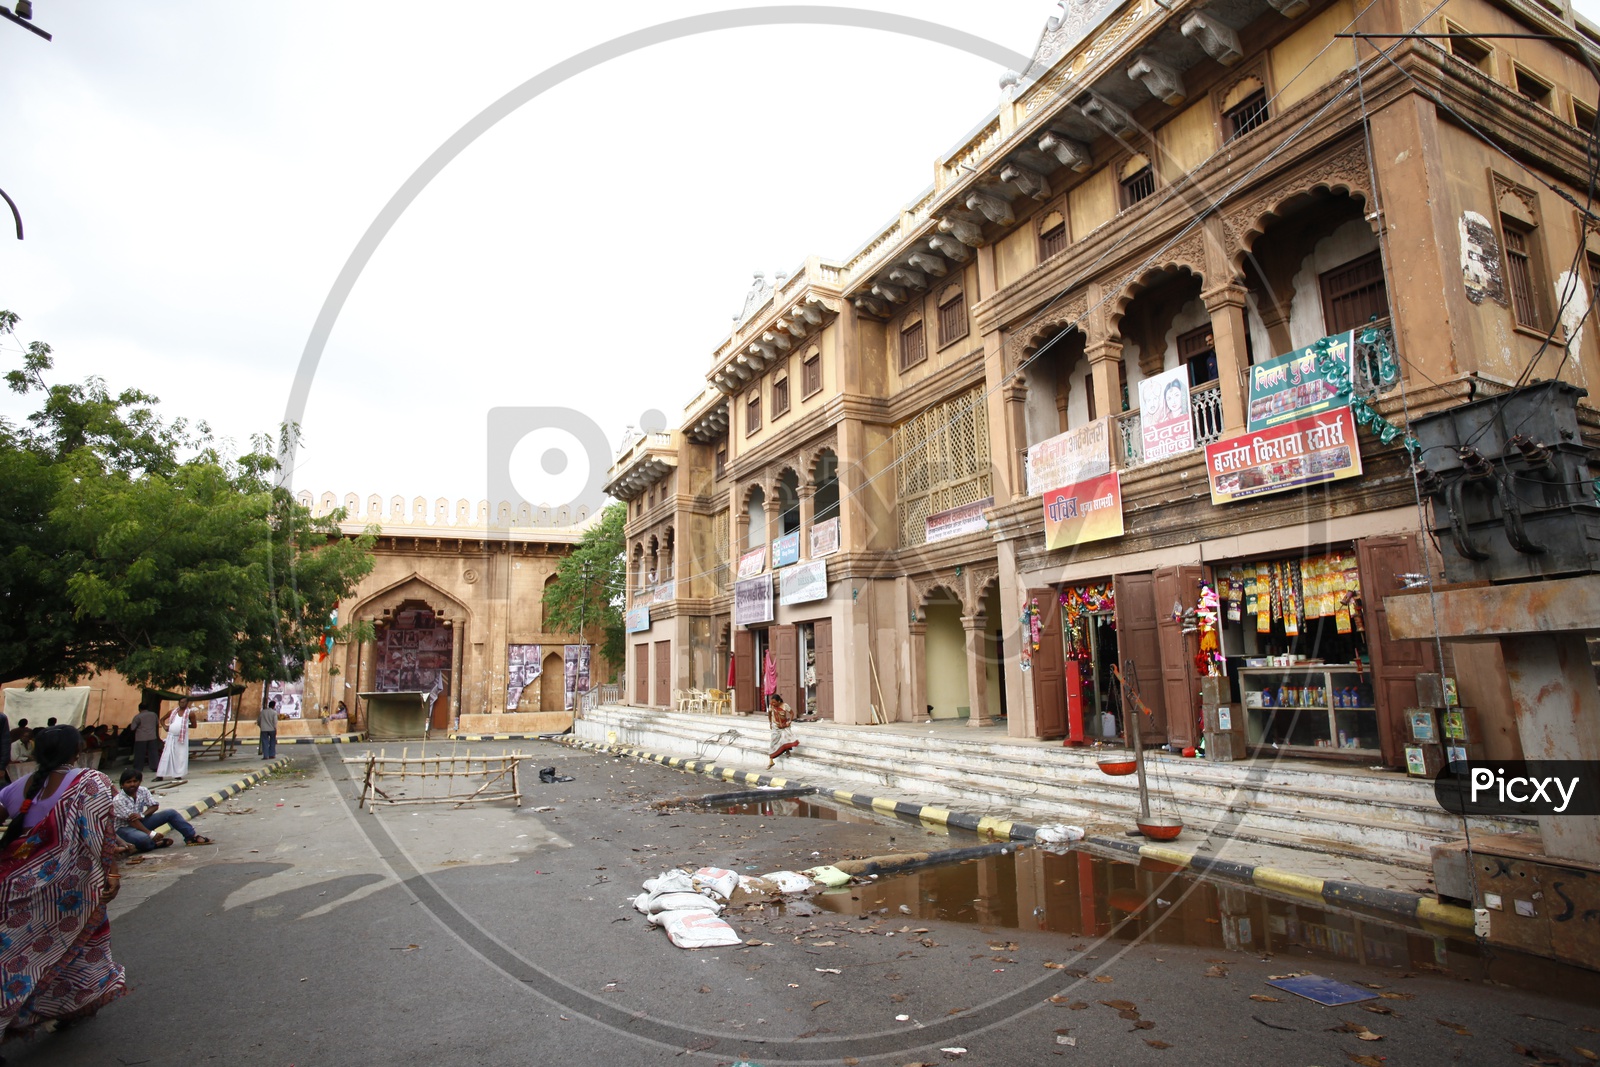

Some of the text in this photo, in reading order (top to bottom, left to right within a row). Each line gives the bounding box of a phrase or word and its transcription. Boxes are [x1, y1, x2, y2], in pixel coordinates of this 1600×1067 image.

[1144, 421, 1190, 443] चेतन
[1212, 414, 1345, 472] बजरंग किराना स्टोर्स
[1048, 495, 1078, 522] पवित्र
